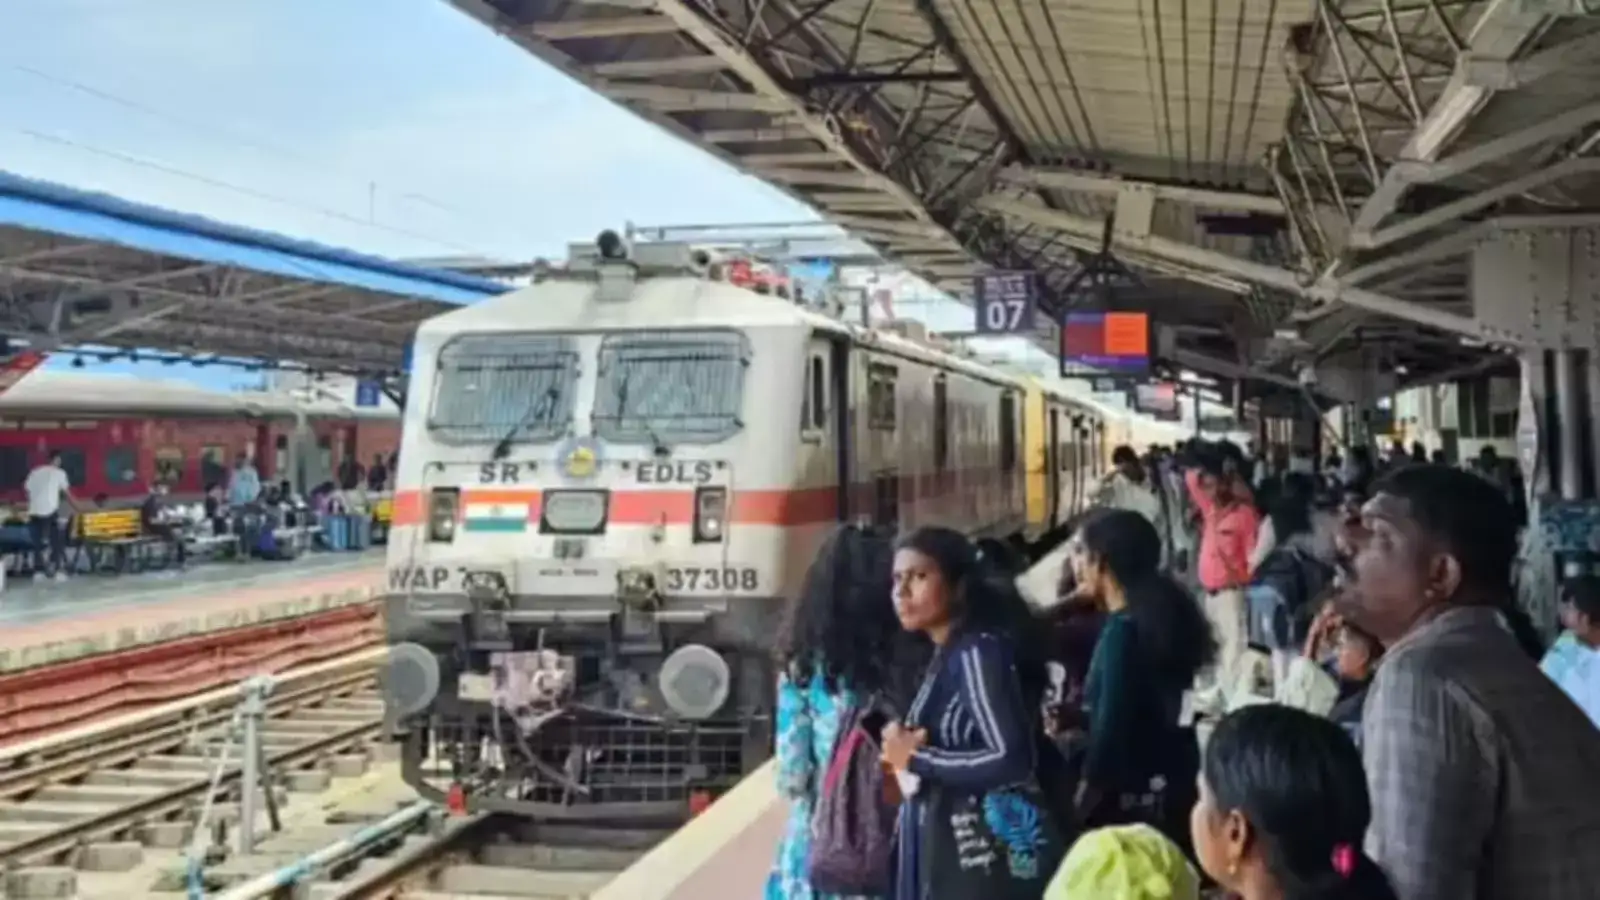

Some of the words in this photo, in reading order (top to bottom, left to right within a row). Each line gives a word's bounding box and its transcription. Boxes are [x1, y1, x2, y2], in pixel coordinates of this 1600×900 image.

[986, 300, 1025, 330] 07
[479, 461, 520, 483] SR
[636, 461, 712, 483] EDLS
[389, 565, 449, 590] WAP
[667, 568, 759, 591] 37308
